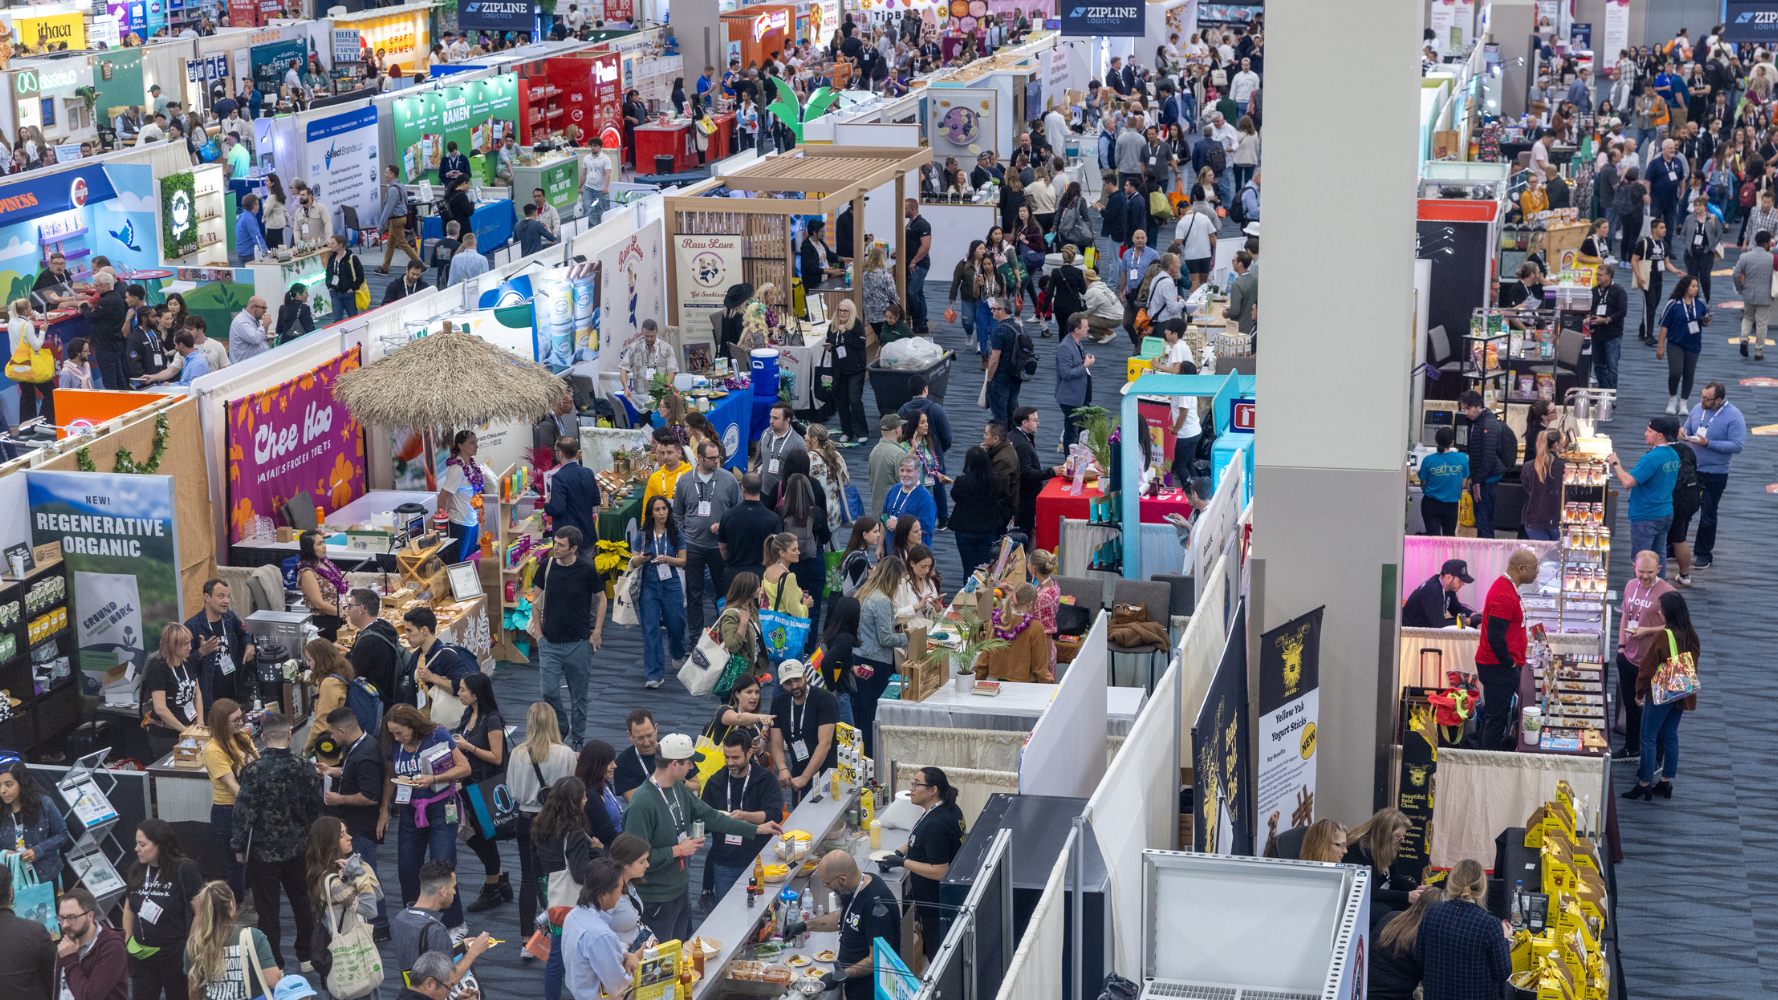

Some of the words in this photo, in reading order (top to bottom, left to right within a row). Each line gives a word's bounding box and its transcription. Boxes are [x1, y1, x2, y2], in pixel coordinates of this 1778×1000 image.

[481, 3, 527, 14] ZIPLINE
[1087, 7, 1137, 18] ZIPLINE
[37, 22, 72, 39] ithaca
[389, 33, 413, 44] CRAFT
[388, 44, 414, 56] RAMEN
[336, 53, 360, 61] KELP
[442, 105, 470, 125] RAMEN
[326, 147, 342, 159] Select
[341, 144, 357, 156] Brands
[550, 183, 559, 194] YES,
[553, 192, 568, 205] VEGAN!
[681, 238, 707, 249] Raw
[707, 238, 735, 249] Love
[690, 290, 700, 299] Get
[700, 290, 727, 298] Sunkisse
[254, 421, 299, 465] Chee
[303, 400, 333, 445] Hoo
[486, 430, 508, 440] ORGANIC
[286, 452, 309, 471] FROZE
[1430, 463, 1463, 476] eathos
[85, 495, 111, 506] NEW!
[36, 512, 165, 537] REGENERATIVE
[63, 536, 141, 557] ORGANIC
[83, 601, 118, 629] GROUND
[108, 603, 134, 625] WORK
[1275, 707, 1294, 724] Yellow
[1294, 701, 1305, 714] Yak
[1271, 725, 1290, 742] Yogurt
[1290, 716, 1307, 732] Sticks
[1301, 729, 1316, 754] NEW
[493, 815, 513, 826] Original
